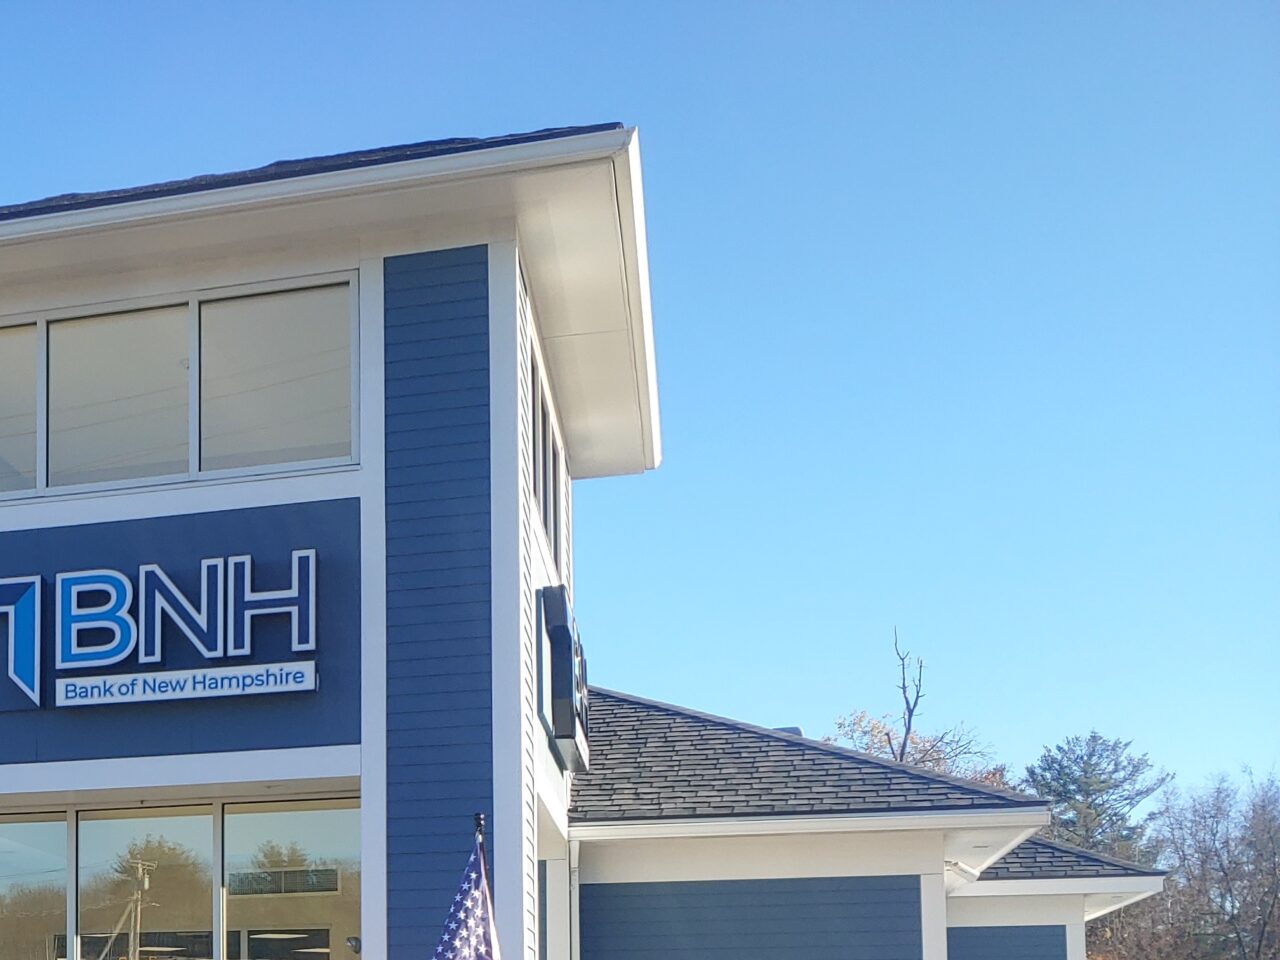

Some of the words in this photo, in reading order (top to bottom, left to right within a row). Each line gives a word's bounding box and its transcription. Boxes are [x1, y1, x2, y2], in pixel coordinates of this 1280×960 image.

[55, 548, 316, 670] BNH
[64, 681, 116, 700] Bank
[118, 678, 139, 697] of
[142, 676, 187, 695] New
[192, 667, 306, 692] Hampshire
